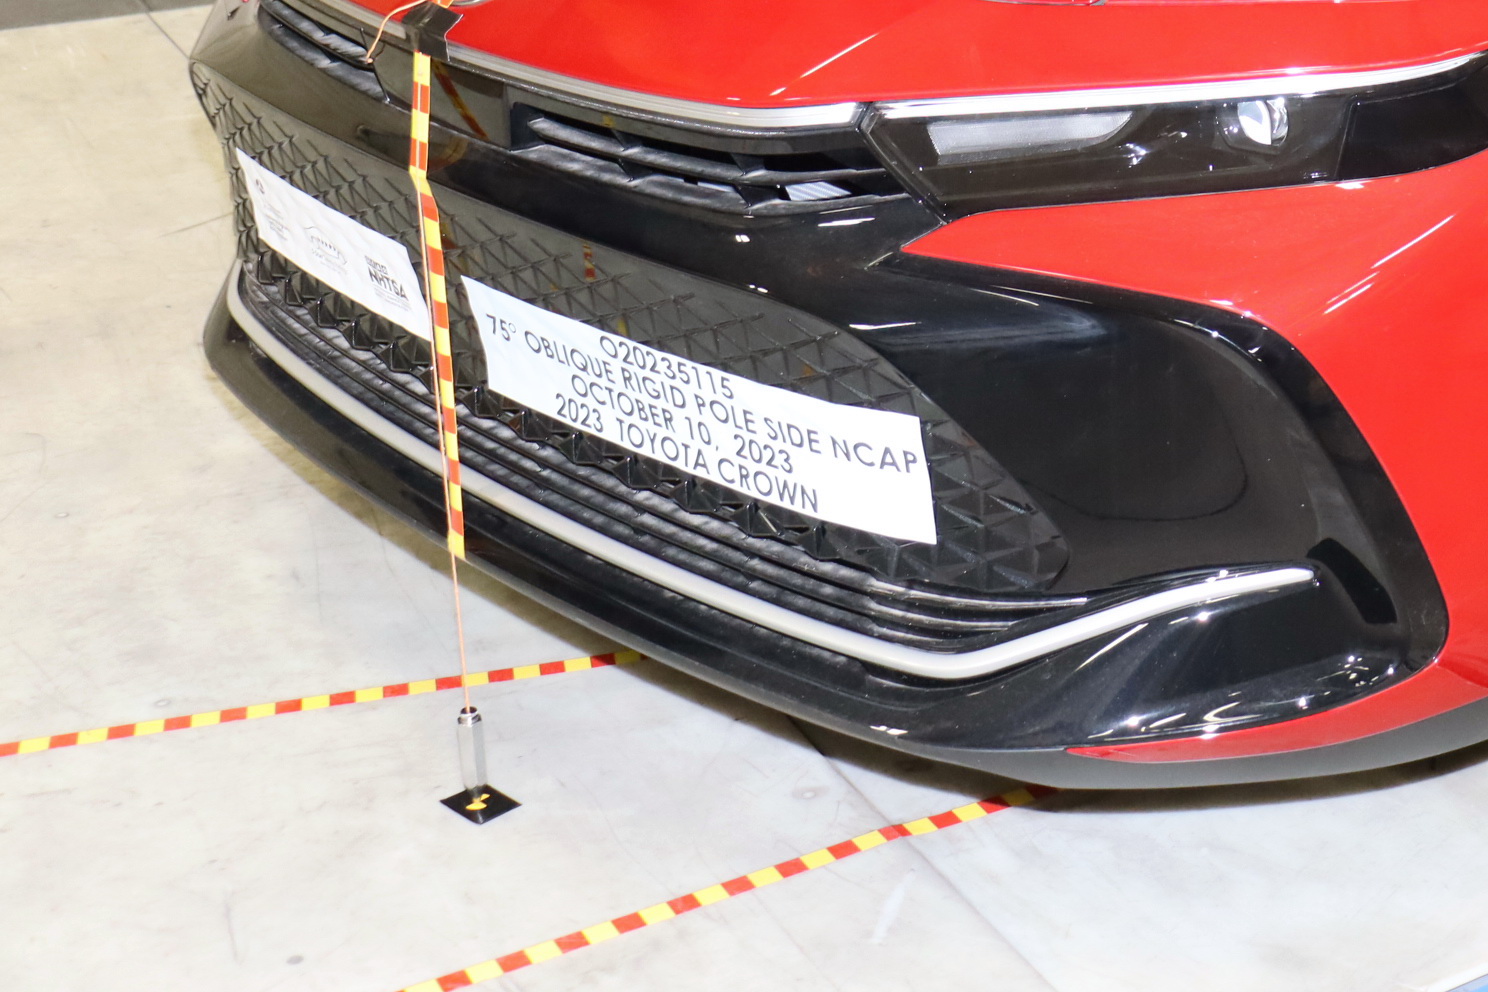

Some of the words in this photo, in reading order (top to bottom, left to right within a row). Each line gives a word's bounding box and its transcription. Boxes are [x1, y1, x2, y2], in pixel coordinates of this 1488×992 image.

[367, 266, 410, 301] NHTSA
[485, 314, 516, 343] 75°
[524, 330, 616, 385] OBLIQUE
[621, 369, 687, 410] RIGID
[698, 393, 757, 436] POLE
[765, 415, 822, 454] SIDE
[829, 435, 918, 475] NCAP
[570, 374, 675, 434] OCTOBER
[685, 415, 720, 453] 10,
[734, 434, 793, 475] 2023
[555, 393, 604, 433] 2023
[616, 416, 710, 476] TOYOTA
[717, 460, 819, 513] CROWN
